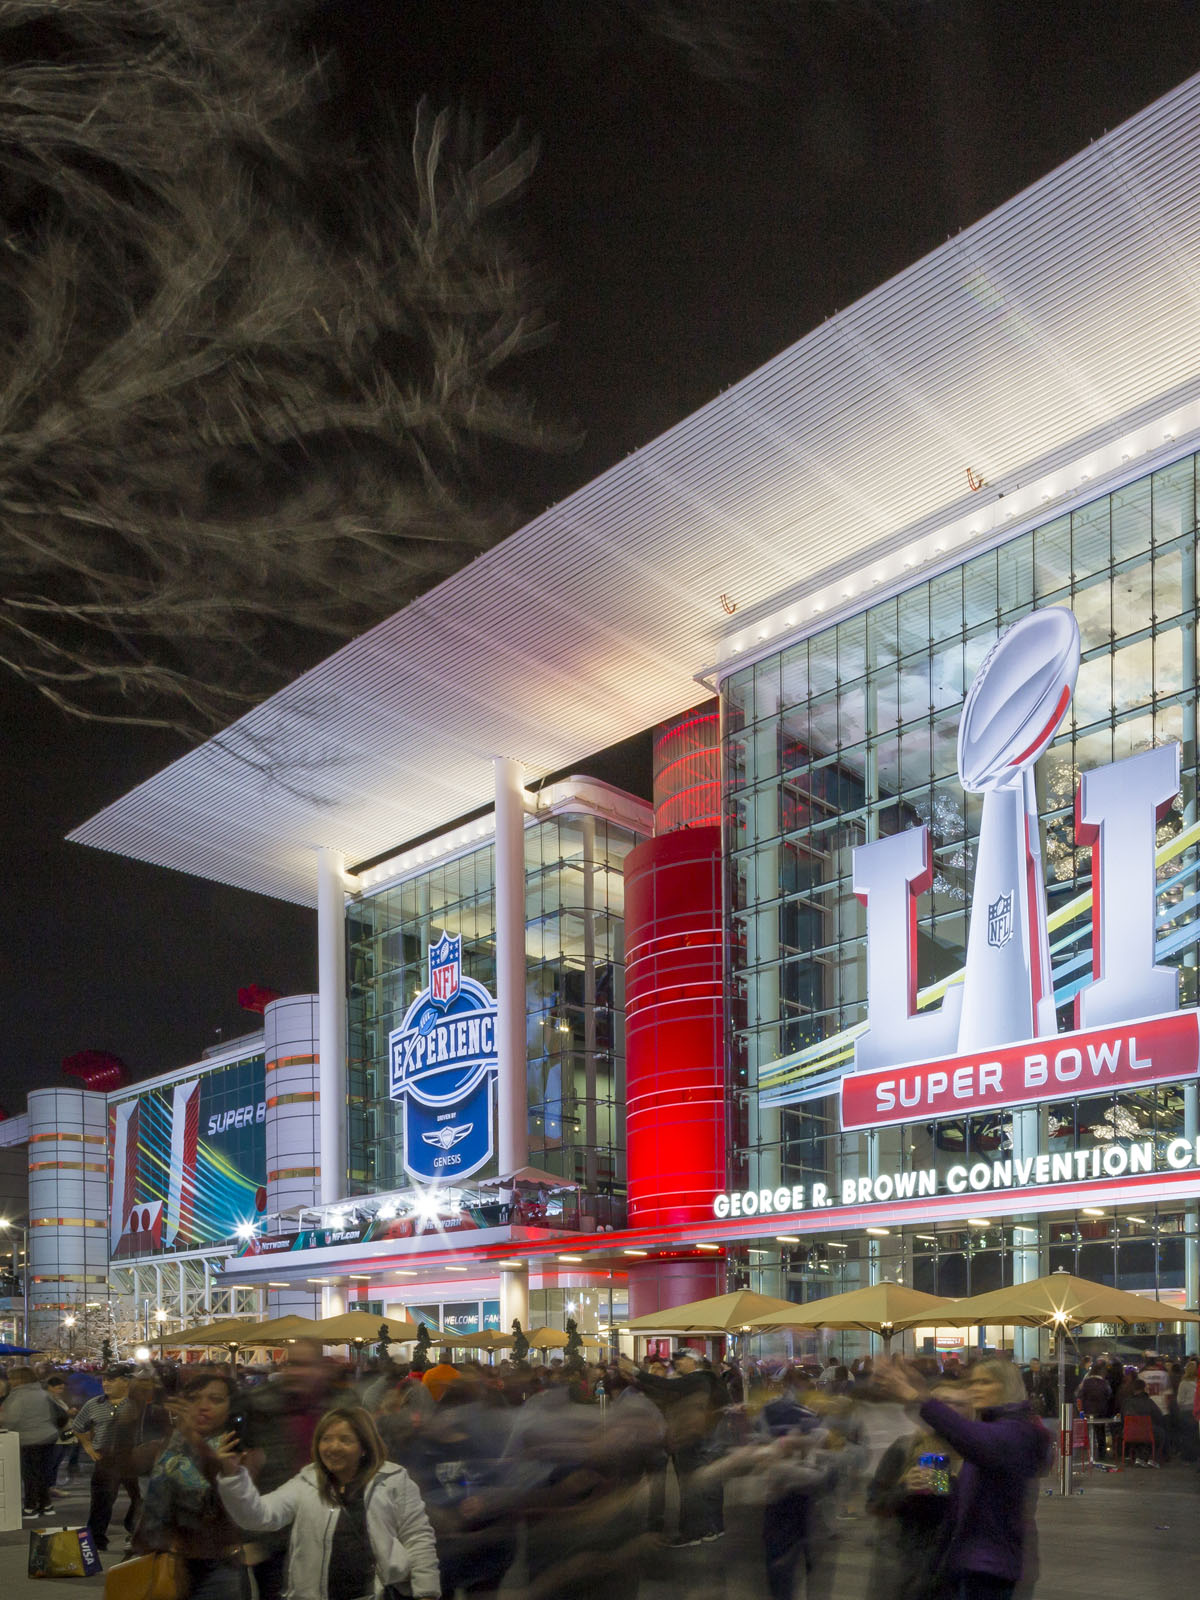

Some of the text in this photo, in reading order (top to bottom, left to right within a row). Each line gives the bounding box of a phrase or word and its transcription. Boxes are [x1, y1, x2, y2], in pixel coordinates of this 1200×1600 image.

[989, 915, 1009, 942] NFL
[432, 964, 458, 1000] NFL
[876, 1037, 1152, 1112] SUPER BOWL
[207, 1105, 253, 1136] SUPER
[433, 1154, 461, 1167] GENESIS
[713, 1185, 804, 1218] GEORGE
[812, 1182, 833, 1207] R.
[842, 1169, 936, 1205] BROWN
[947, 1142, 1152, 1193] CONVENTION
[444, 1314, 500, 1325] WELCOME FAN
[80, 1539, 95, 1565] VISA
